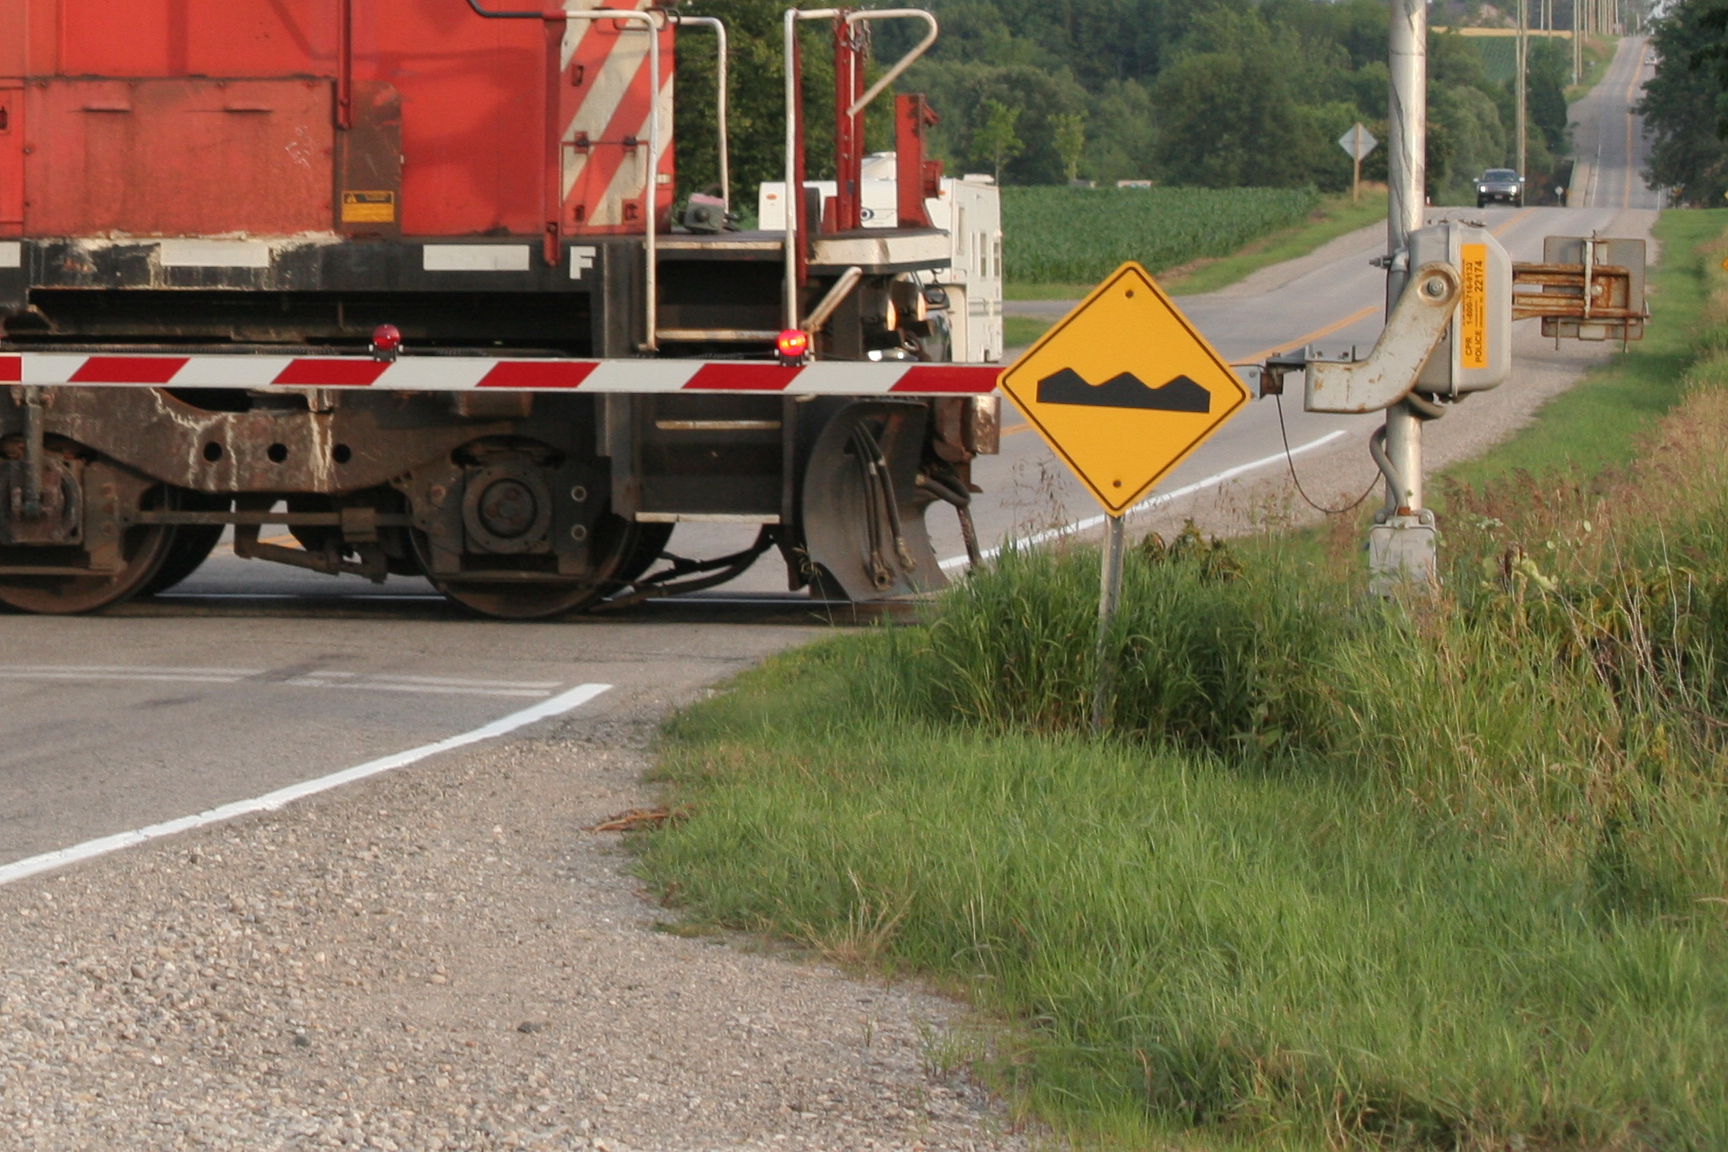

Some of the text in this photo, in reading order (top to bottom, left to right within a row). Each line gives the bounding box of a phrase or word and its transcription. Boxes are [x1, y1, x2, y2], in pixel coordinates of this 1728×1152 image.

[569, 245, 596, 280] F
[1475, 260, 1484, 292] 22174
[1475, 330, 1483, 363] POLICE
